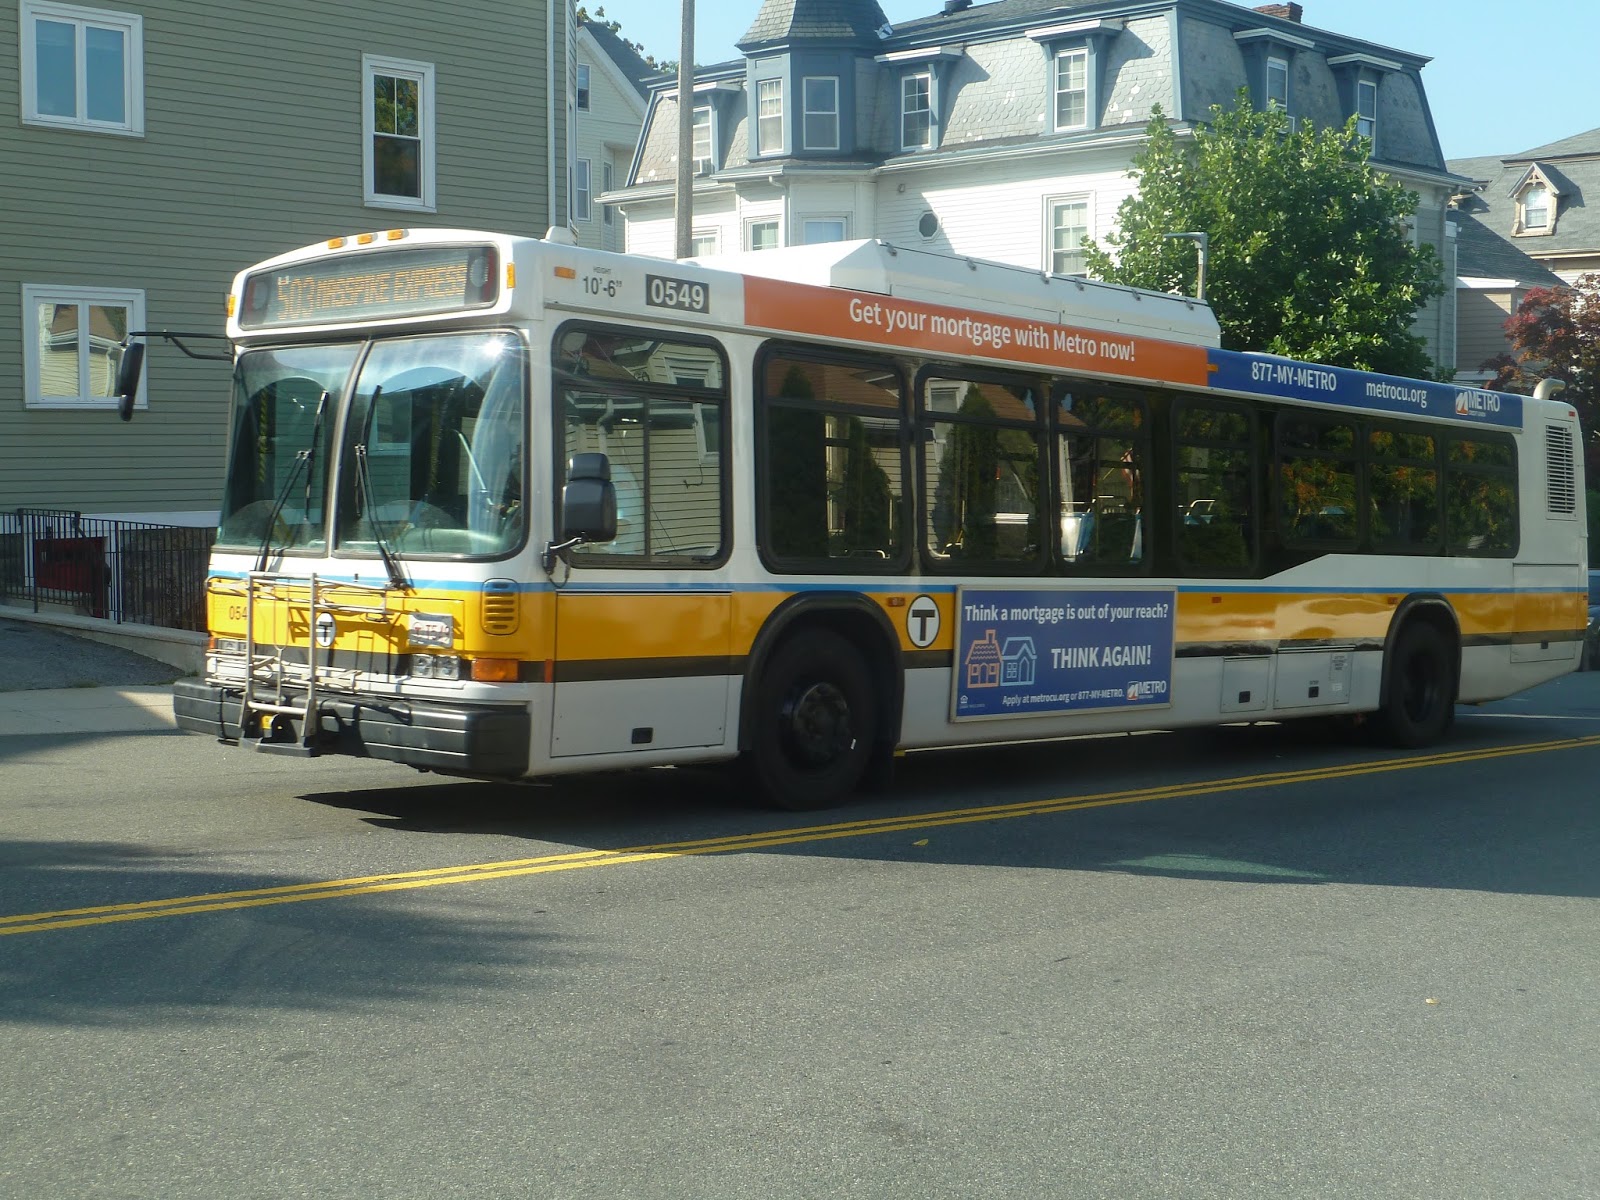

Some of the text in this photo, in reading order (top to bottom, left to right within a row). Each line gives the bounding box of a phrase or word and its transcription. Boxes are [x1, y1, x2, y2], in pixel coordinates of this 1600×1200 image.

[651, 279, 705, 310] 0549
[849, 298, 1135, 362] Get your mortgage with Metro now!
[1251, 361, 1337, 392] 877-MY-METRO
[1366, 381, 1427, 408] metrocu.org
[1468, 390, 1500, 412] METRO
[911, 609, 936, 641] T
[965, 603, 1169, 625] Think a mortgage is out of your reach?
[318, 621, 333, 643] T
[1051, 644, 1151, 669] THINK AGAIN!
[1002, 693, 1021, 706] Apply
[1022, 694, 1030, 704] at
[1030, 691, 1070, 704] metrocu.org
[1070, 691, 1078, 701] or
[1138, 680, 1167, 694] METRO
